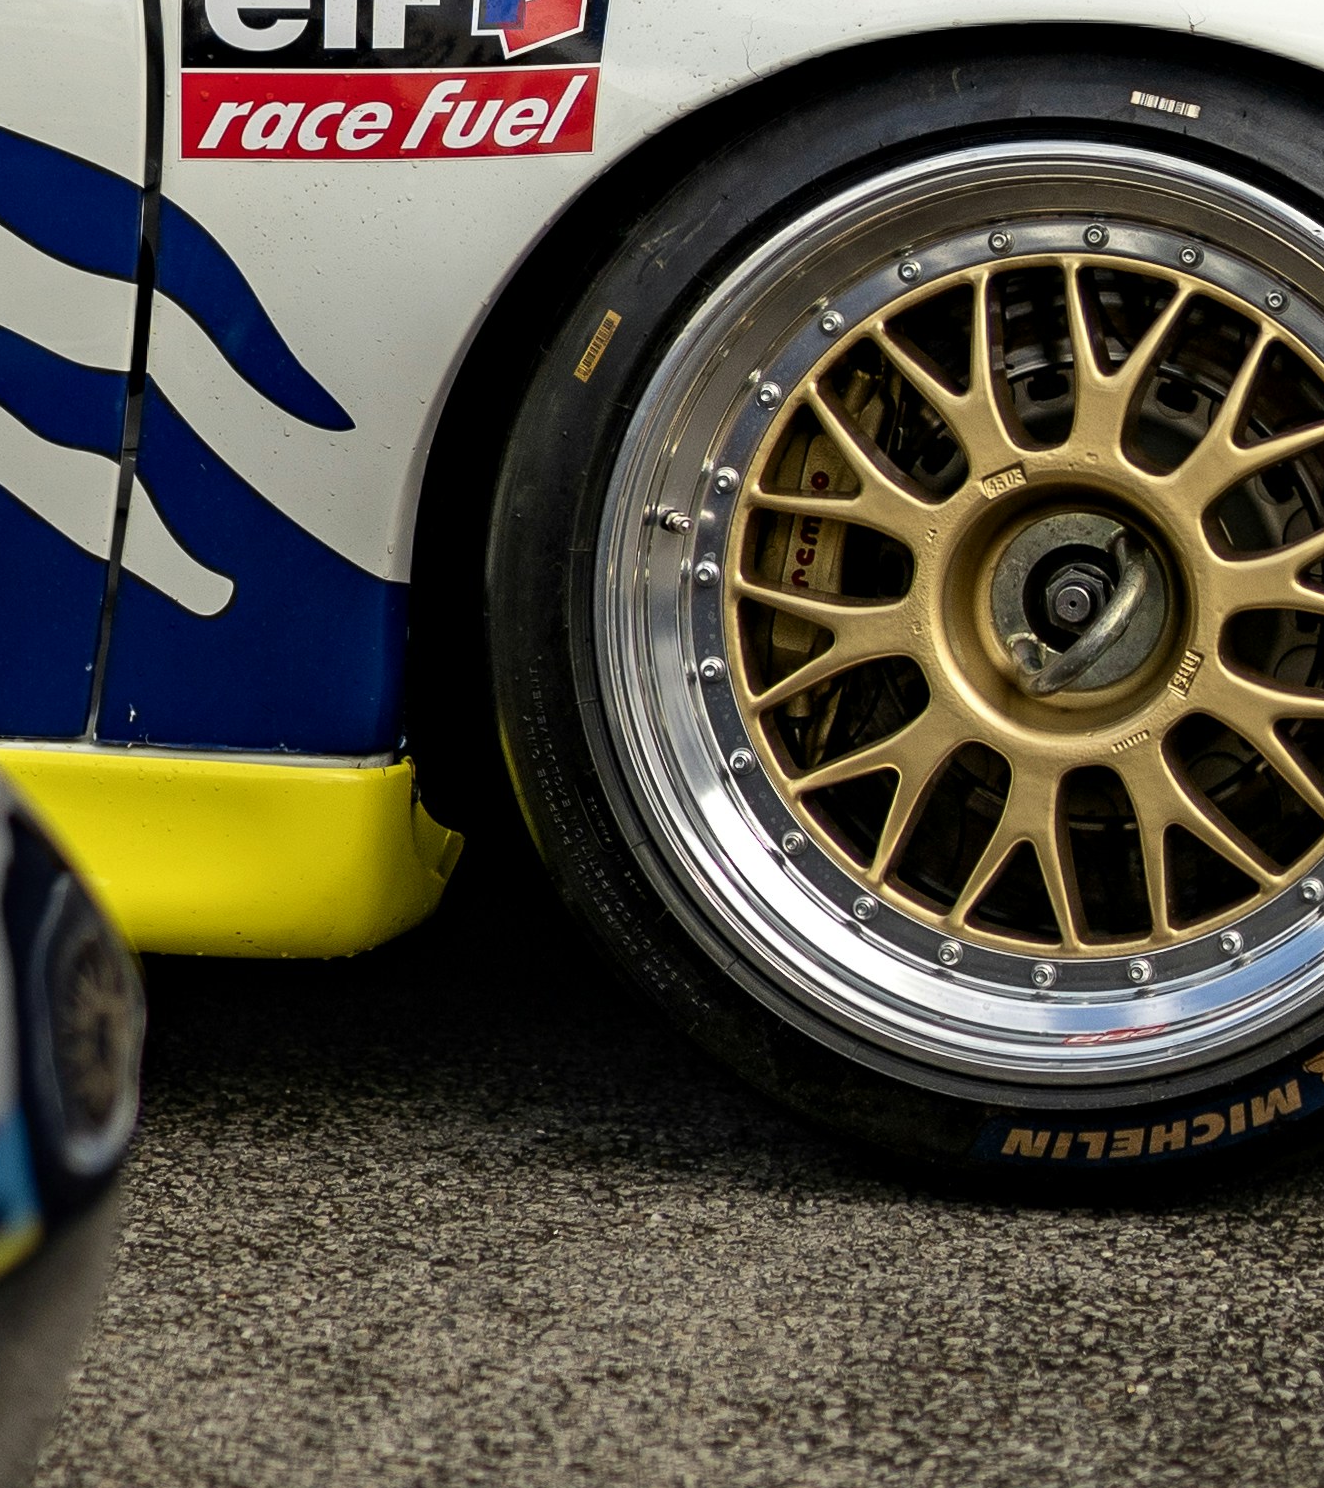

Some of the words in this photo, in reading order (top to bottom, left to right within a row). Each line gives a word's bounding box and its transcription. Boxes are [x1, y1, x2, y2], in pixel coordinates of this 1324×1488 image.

[198, 100, 404, 151] race
[404, 75, 589, 151] fuel
[1000, 1078, 1303, 1160] MICHELIN
